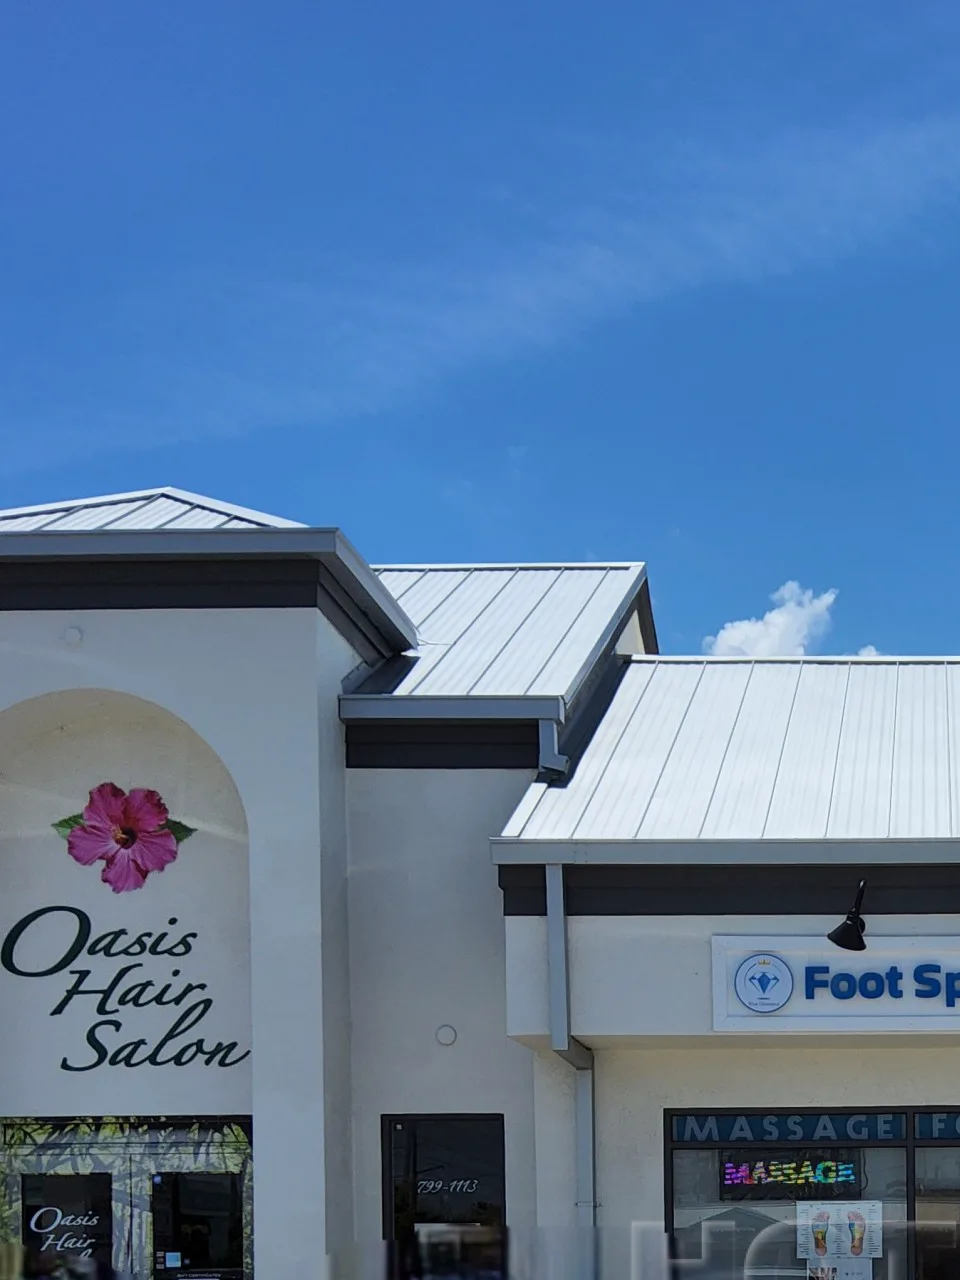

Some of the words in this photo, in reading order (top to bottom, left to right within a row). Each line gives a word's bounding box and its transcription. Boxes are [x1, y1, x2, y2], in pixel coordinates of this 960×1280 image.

[1, 905, 198, 977] Oasis
[50, 963, 207, 1017] Hair
[804, 965, 904, 1000] Foot
[60, 998, 251, 1072] Salon
[683, 1114, 894, 1142] MASSAGE
[724, 1160, 856, 1184] MASSAGE
[417, 1180, 479, 1194] 799-1113
[30, 1206, 100, 1233] Oasis
[40, 1232, 96, 1251] Hair
